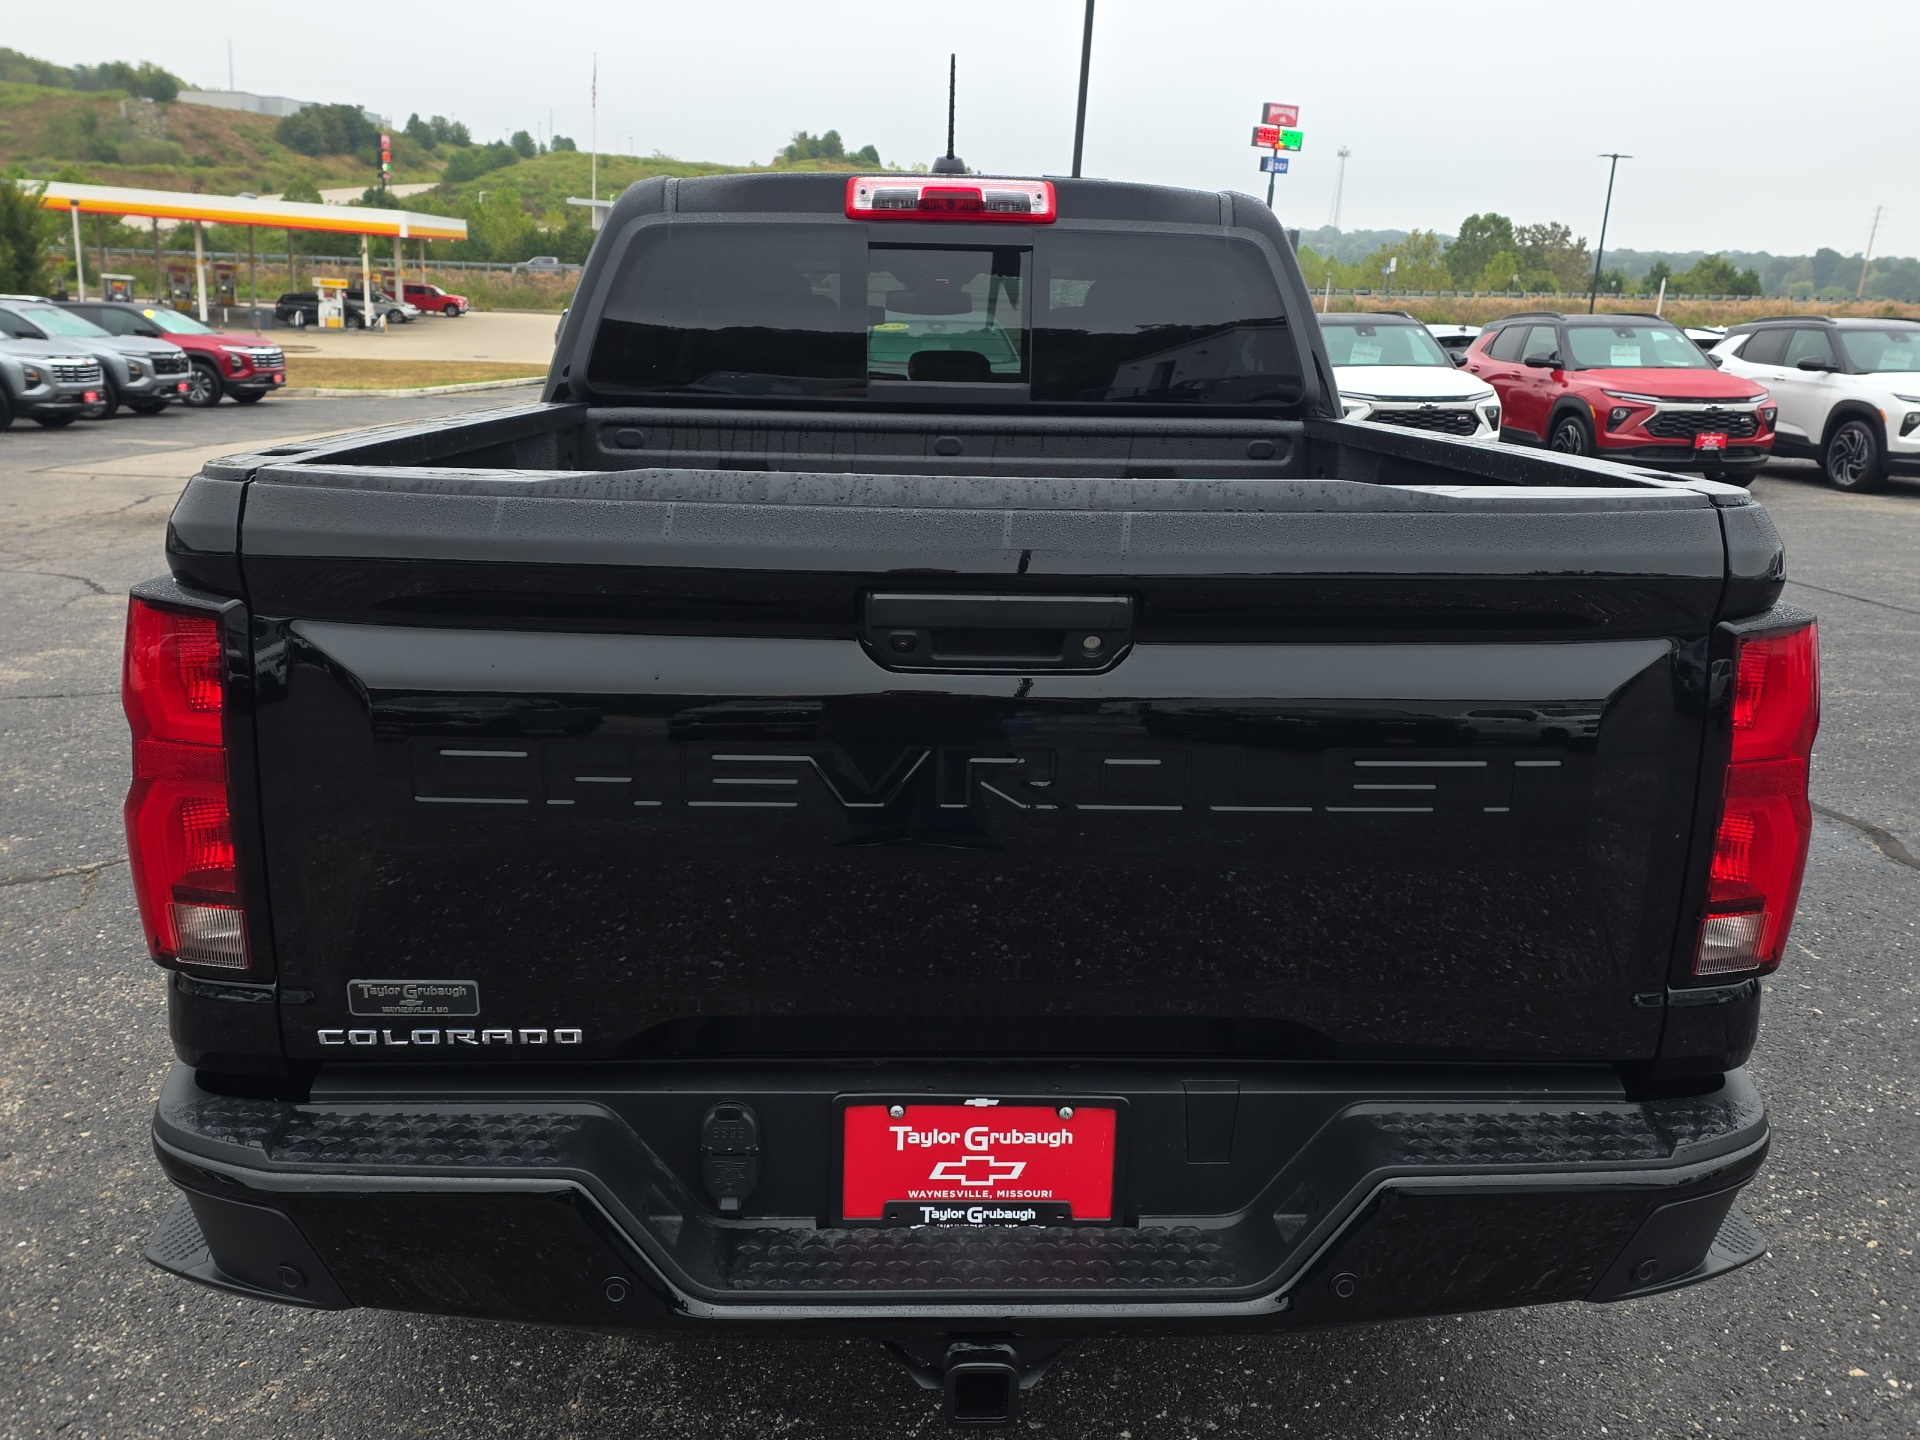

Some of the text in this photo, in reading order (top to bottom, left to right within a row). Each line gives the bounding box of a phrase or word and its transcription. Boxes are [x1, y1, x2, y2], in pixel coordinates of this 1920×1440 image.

[411, 740, 1566, 813] CHEVROLET
[358, 984, 467, 999] Taylor Grubaugh
[317, 1028, 583, 1046] COLORADO
[889, 1126, 1073, 1151] Taylor Grubaugh
[907, 1189, 1053, 1199] WAYNESVILLE, MISSOURI
[919, 1206, 1036, 1224] Taylor Grubaugh
